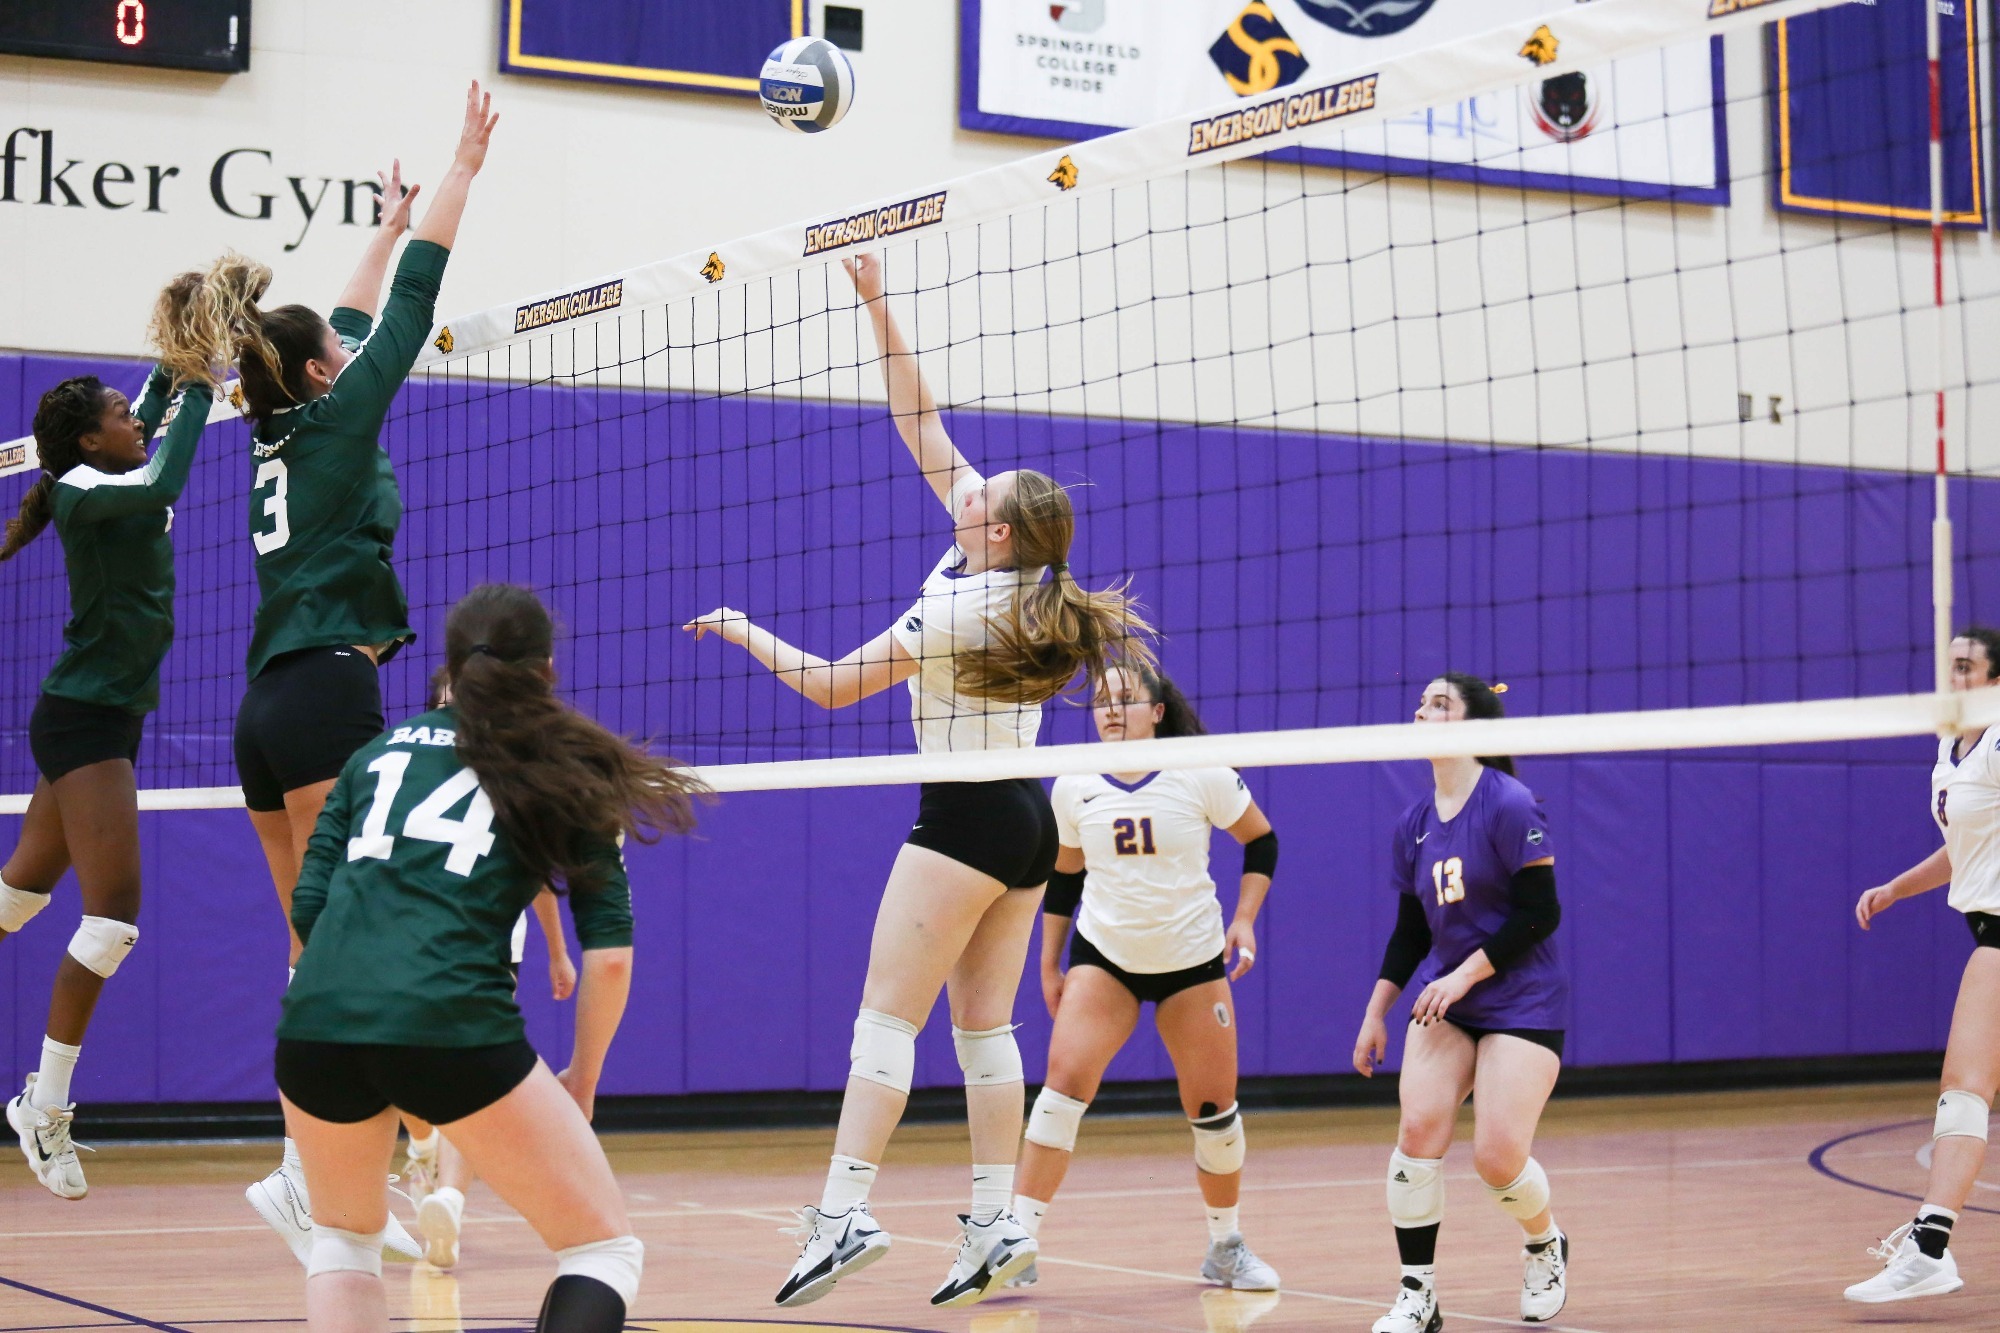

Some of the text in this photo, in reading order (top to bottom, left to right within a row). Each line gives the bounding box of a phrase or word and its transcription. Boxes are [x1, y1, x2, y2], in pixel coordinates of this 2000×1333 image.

[116, 0, 144, 45] 0
[1016, 34, 1140, 60] SPRINGFIELD
[1037, 56, 1117, 76] COLLEGE
[1050, 76, 1103, 93] PRIDE
[1189, 100, 1285, 153] EMERSON
[1285, 76, 1377, 128] COLLEGE
[0, 127, 180, 213] fker
[804, 193, 946, 255] EMERSON COLLEGE
[515, 281, 622, 332] EMERSON COLLEGE
[253, 457, 290, 556] 3
[386, 726, 457, 747] BAB
[347, 751, 496, 877] 14
[1112, 815, 1157, 856] 21
[1432, 856, 1466, 907] 13
